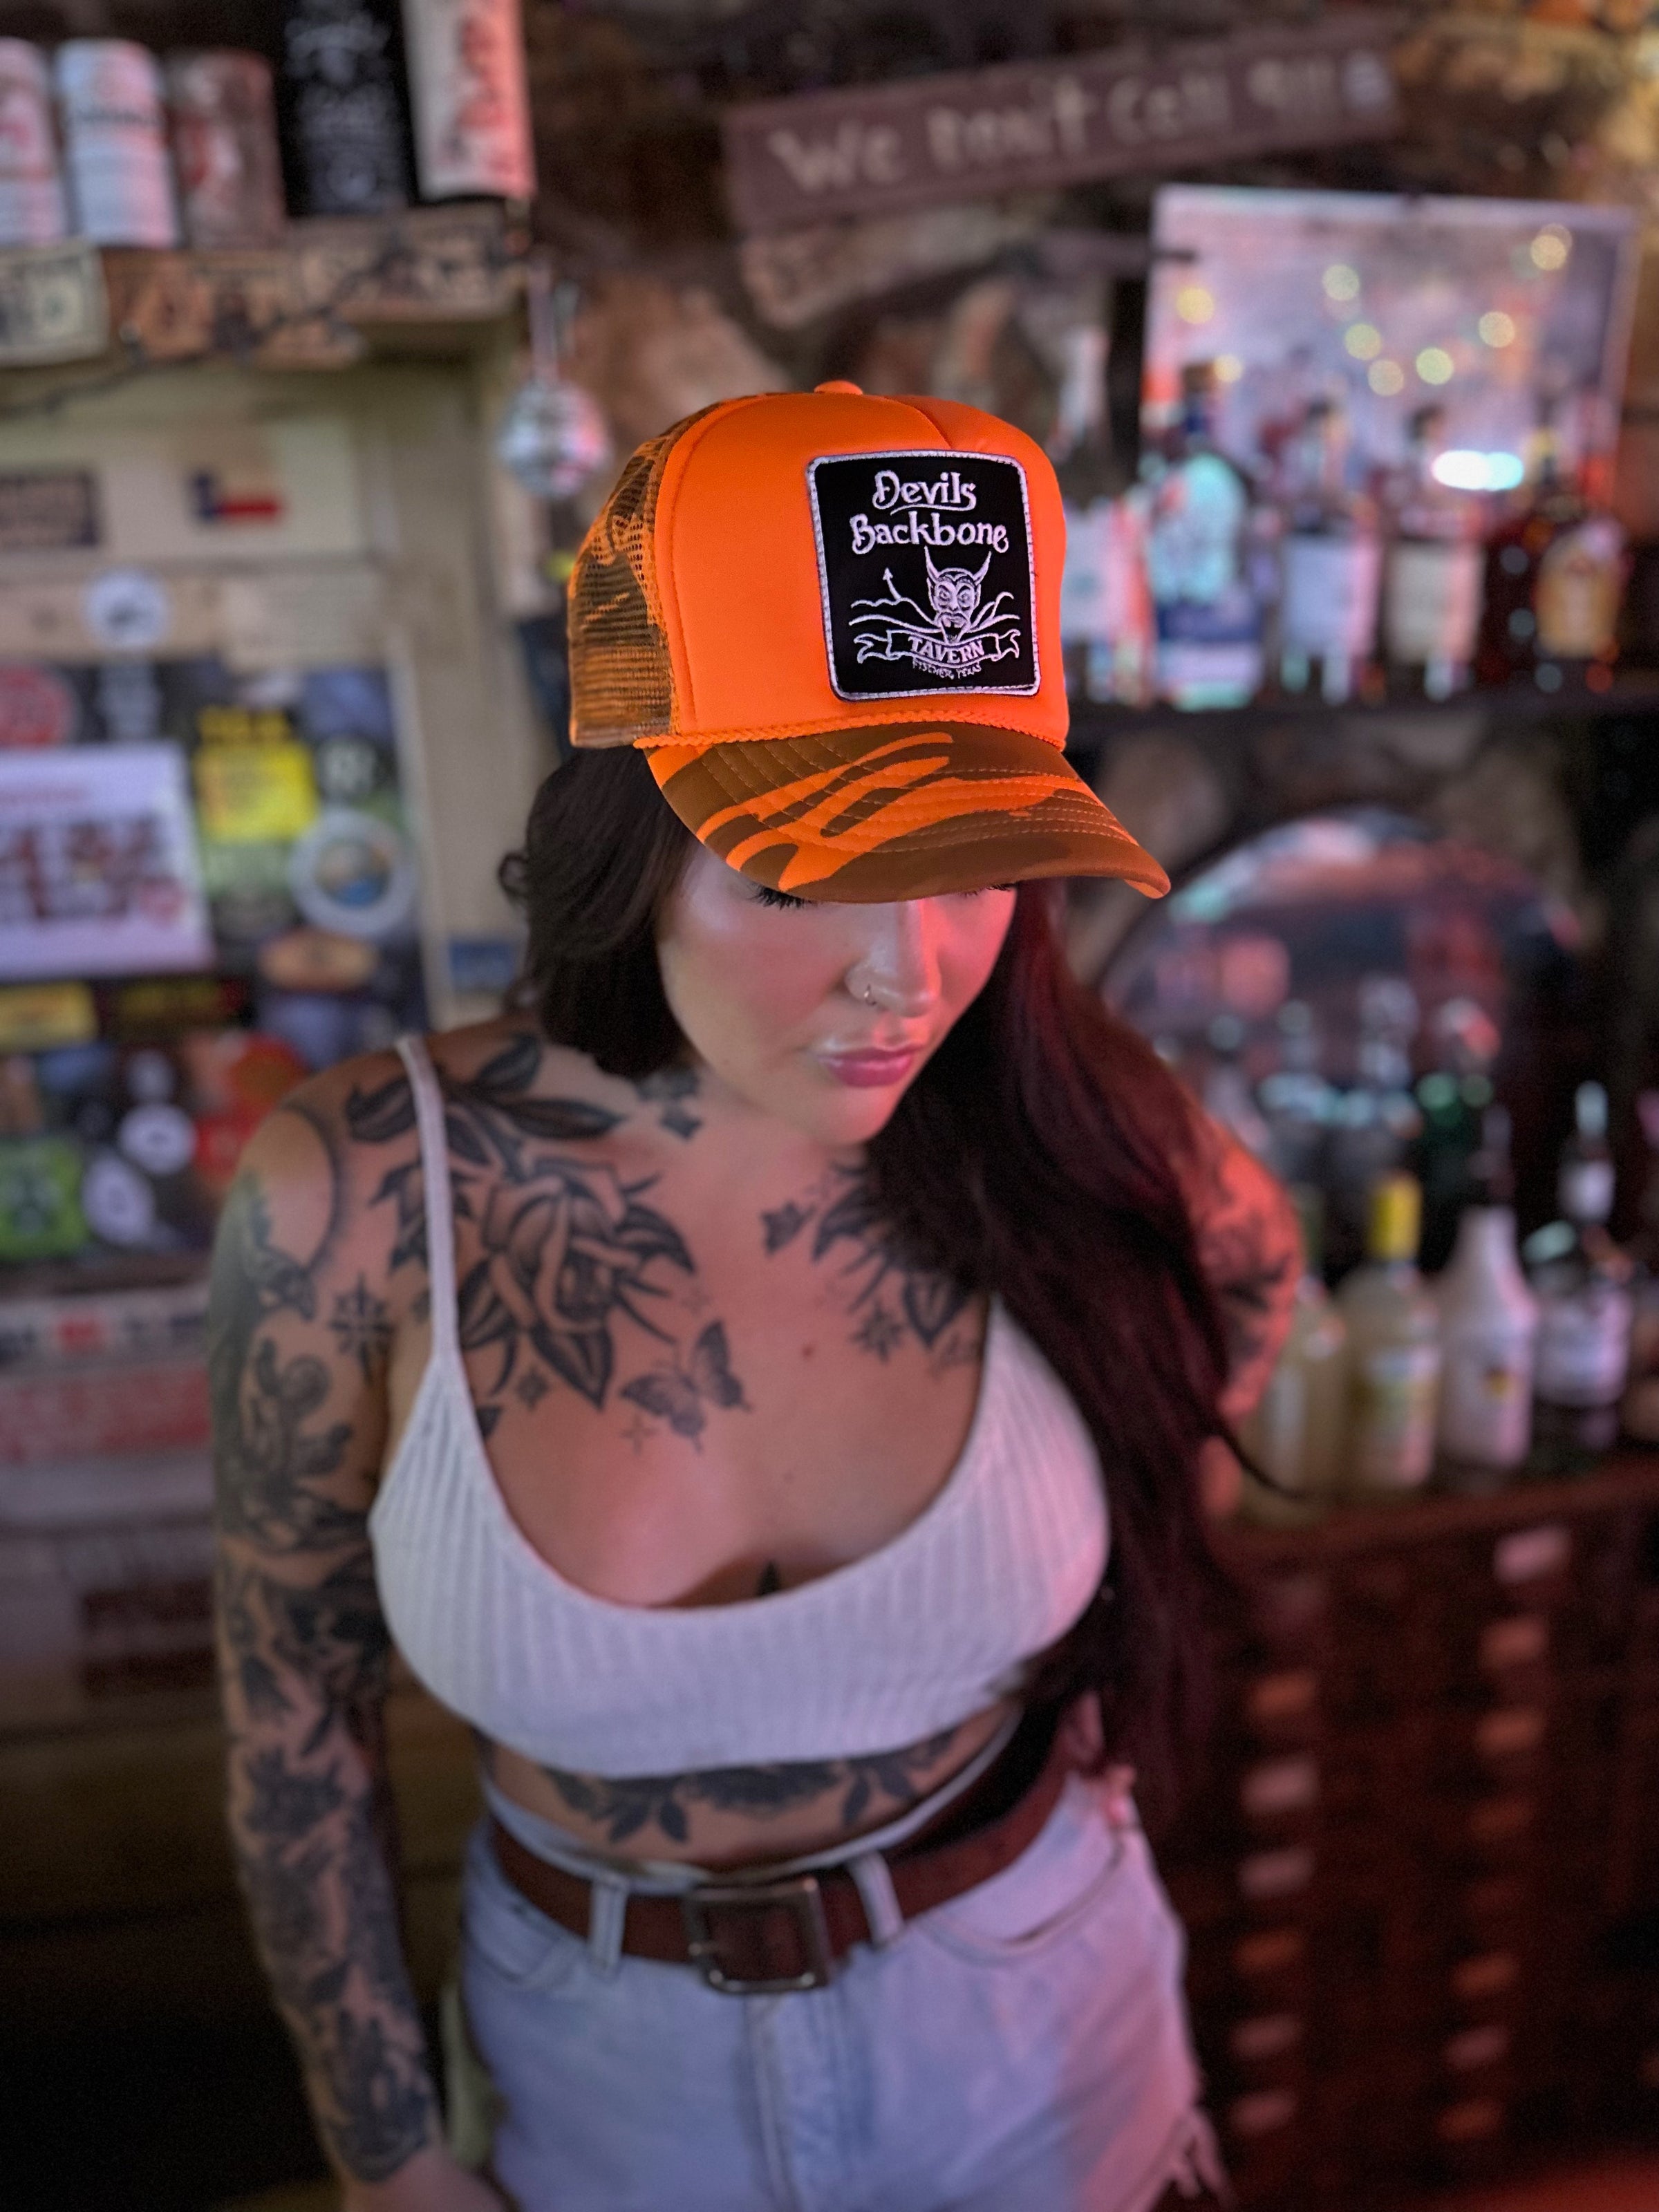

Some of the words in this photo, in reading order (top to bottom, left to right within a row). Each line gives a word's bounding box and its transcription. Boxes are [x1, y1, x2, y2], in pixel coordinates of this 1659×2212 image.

[872, 469, 976, 516] Devils
[849, 510, 1009, 554] Backbone
[907, 635, 985, 664] TAVERN
